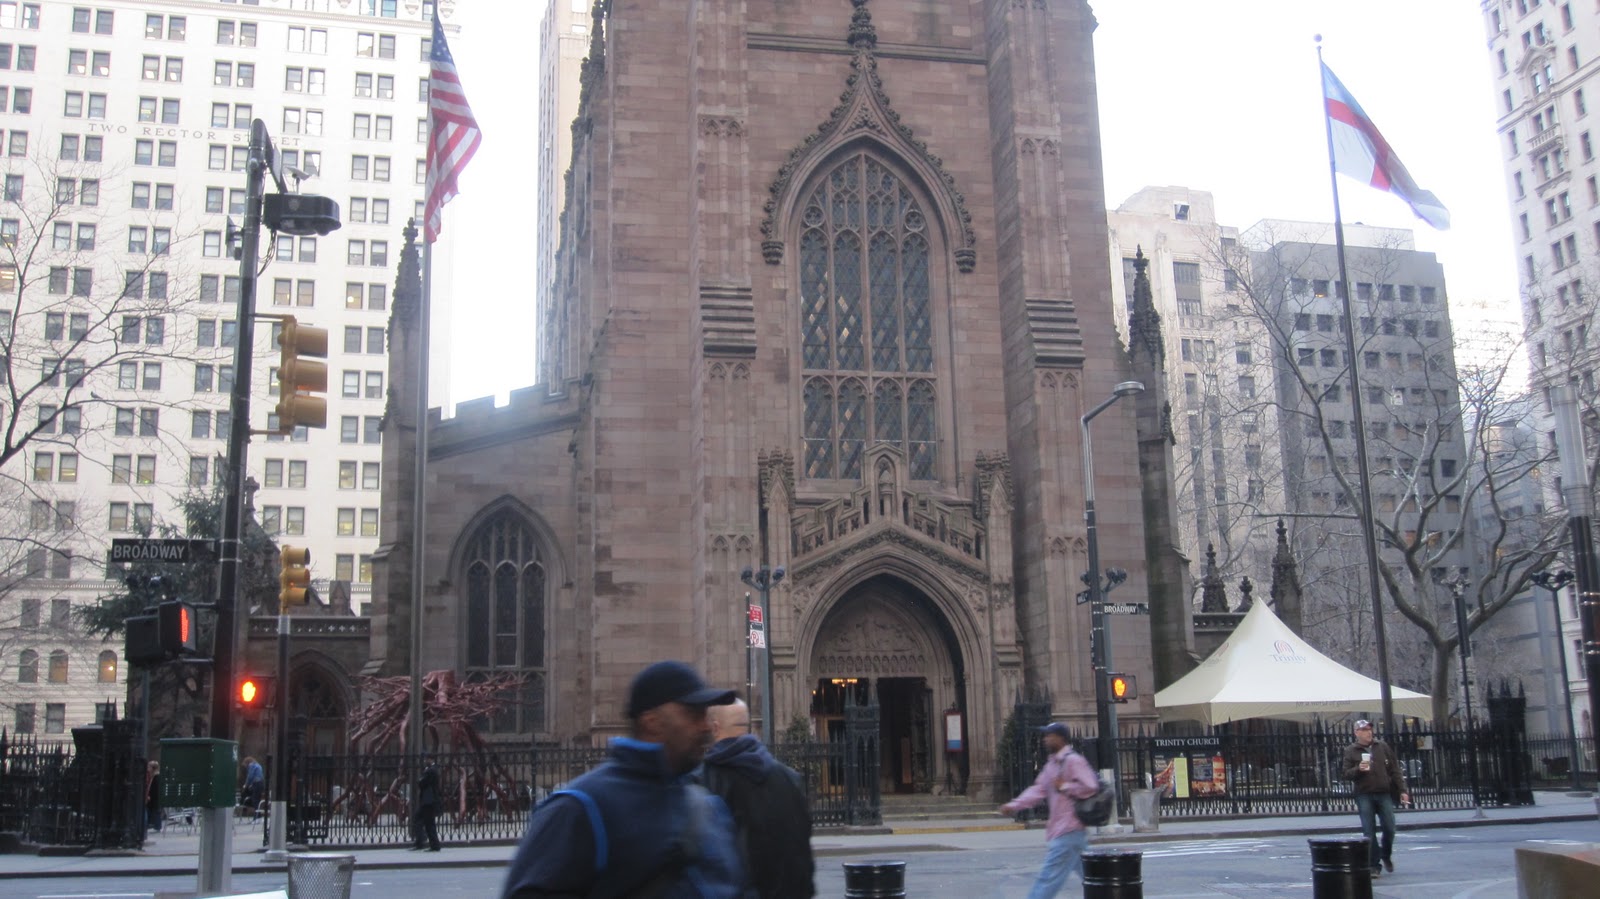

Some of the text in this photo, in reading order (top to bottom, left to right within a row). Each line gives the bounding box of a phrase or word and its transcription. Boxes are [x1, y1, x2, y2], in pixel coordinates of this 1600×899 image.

[88, 123, 301, 146] TWO RECTOR STEET
[113, 545, 185, 559] BROADWAY
[1104, 605, 1137, 614] BROADWAY
[1268, 654, 1306, 662] Trinity
[1154, 737, 1220, 747] TRINITY CHURCH
